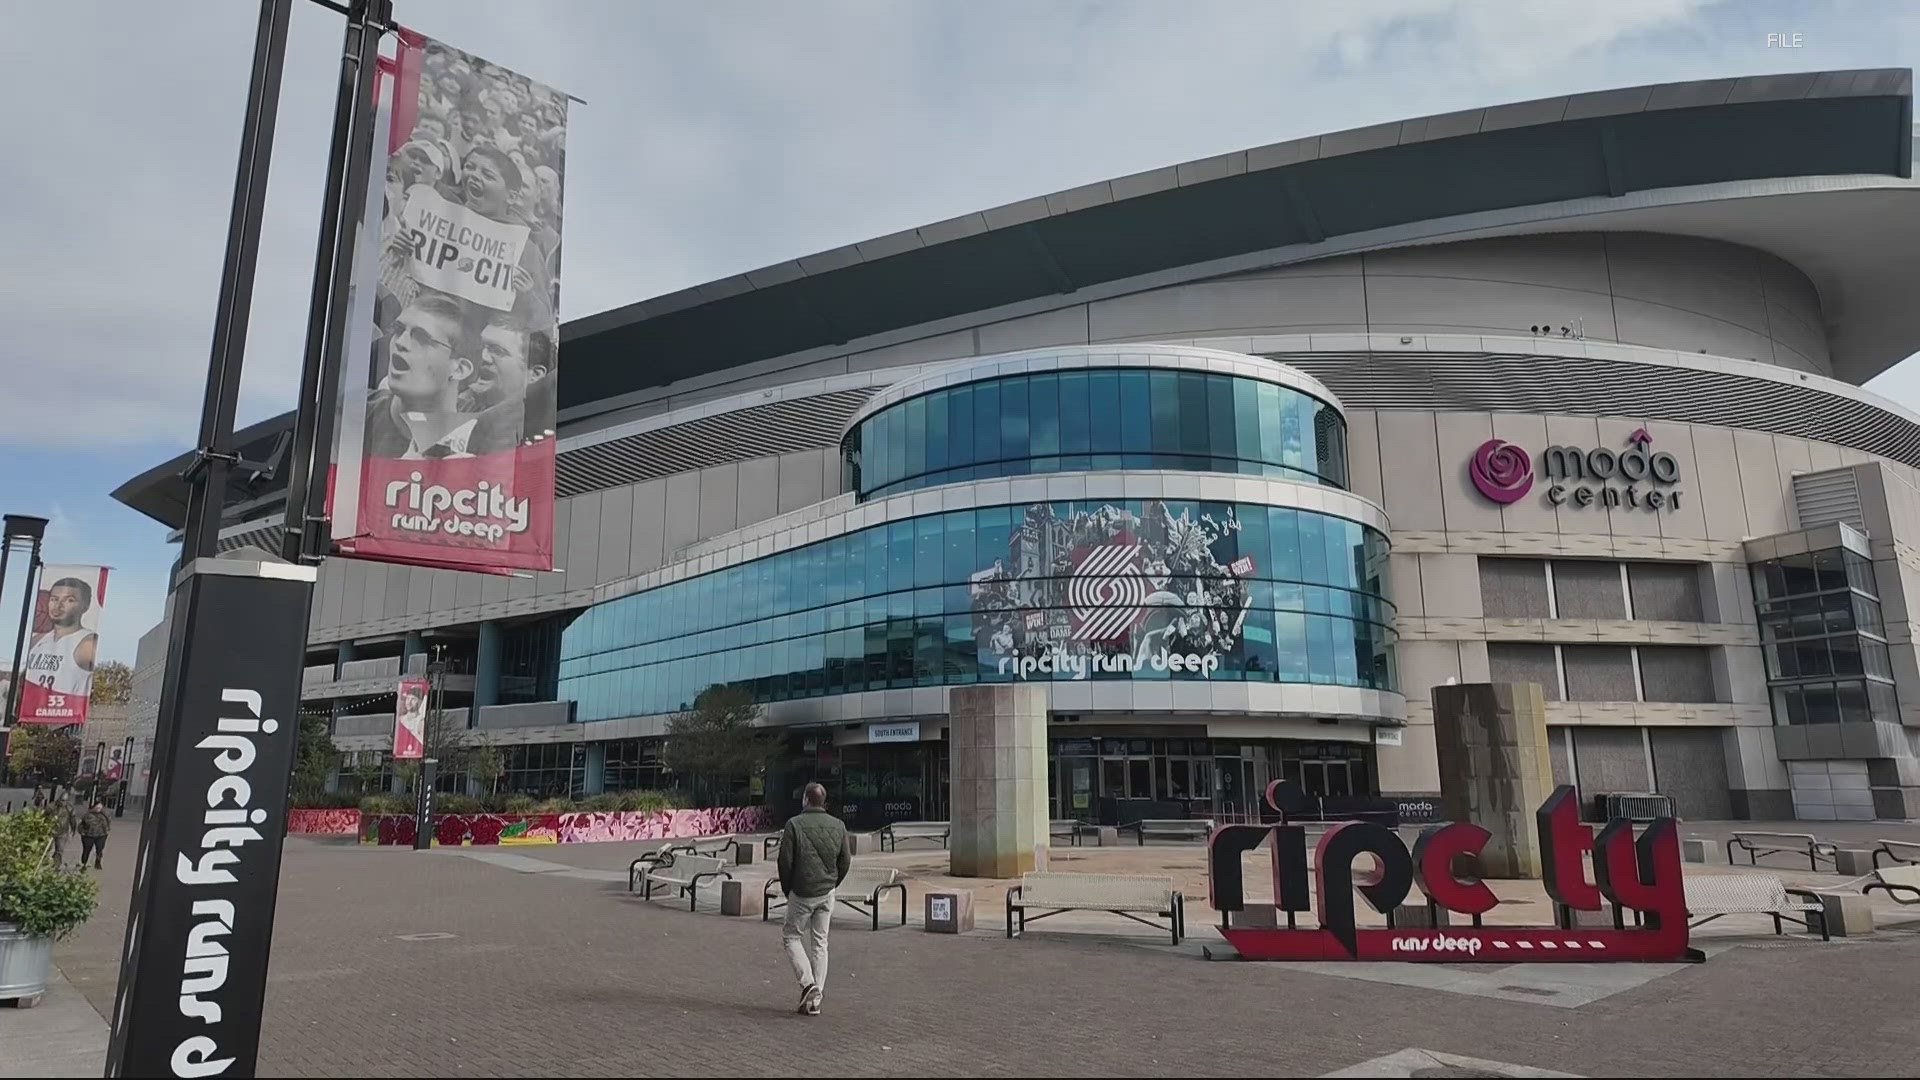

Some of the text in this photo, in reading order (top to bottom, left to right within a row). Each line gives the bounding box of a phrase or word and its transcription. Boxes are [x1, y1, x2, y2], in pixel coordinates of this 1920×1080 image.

[419, 209, 506, 260] WELCOME
[411, 228, 514, 292] RIP CIT
[1544, 430, 1681, 484] moda
[385, 471, 530, 533] ripcity
[1549, 485, 1684, 510] center
[392, 513, 503, 543] runs deep
[998, 647, 1218, 681] ripcity runs deep
[35, 708, 73, 717] CAMARA
[47, 695, 66, 707] 33
[176, 688, 278, 884] ripcity
[885, 802, 912, 811] moda
[1399, 801, 1433, 811] moda
[1392, 932, 1482, 956] runs deep
[179, 899, 235, 1024] runs
